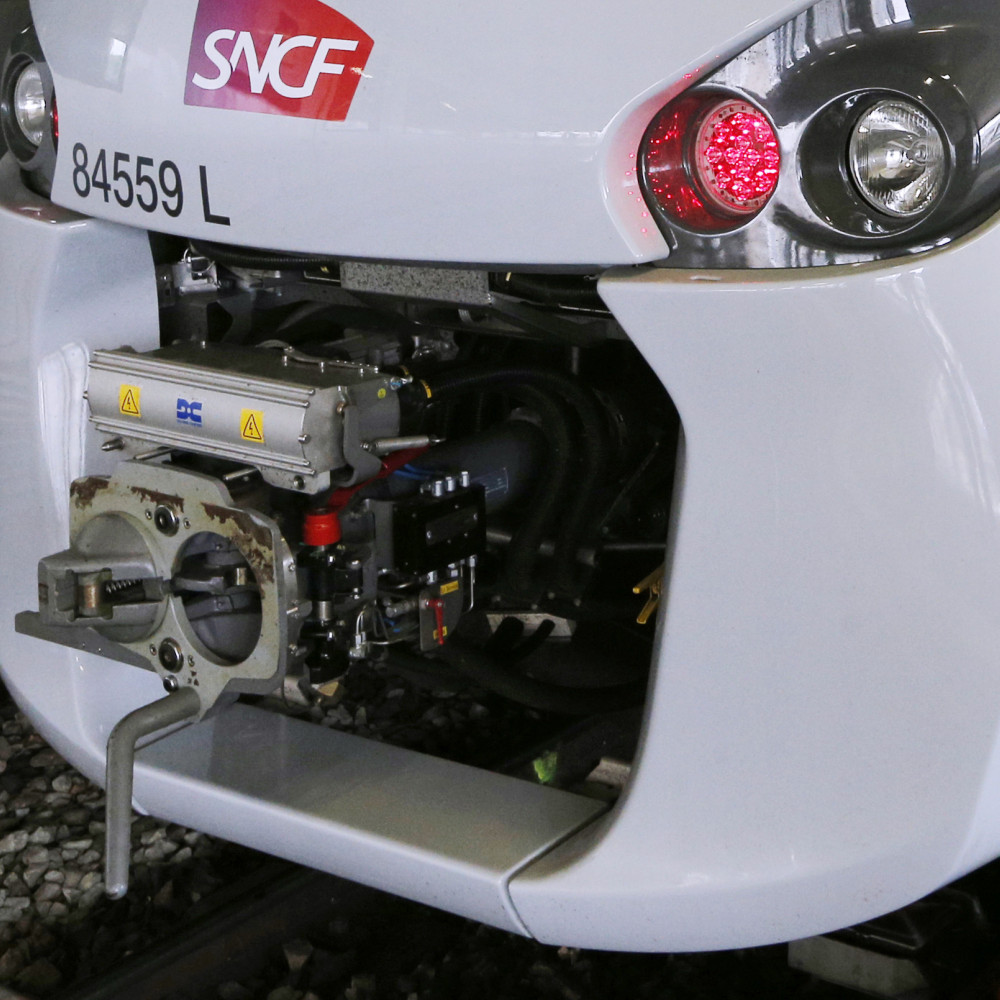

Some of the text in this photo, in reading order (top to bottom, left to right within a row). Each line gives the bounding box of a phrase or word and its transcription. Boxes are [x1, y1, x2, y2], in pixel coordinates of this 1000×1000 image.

[191, 29, 359, 99] SNCF
[72, 142, 231, 226] 84559 L
